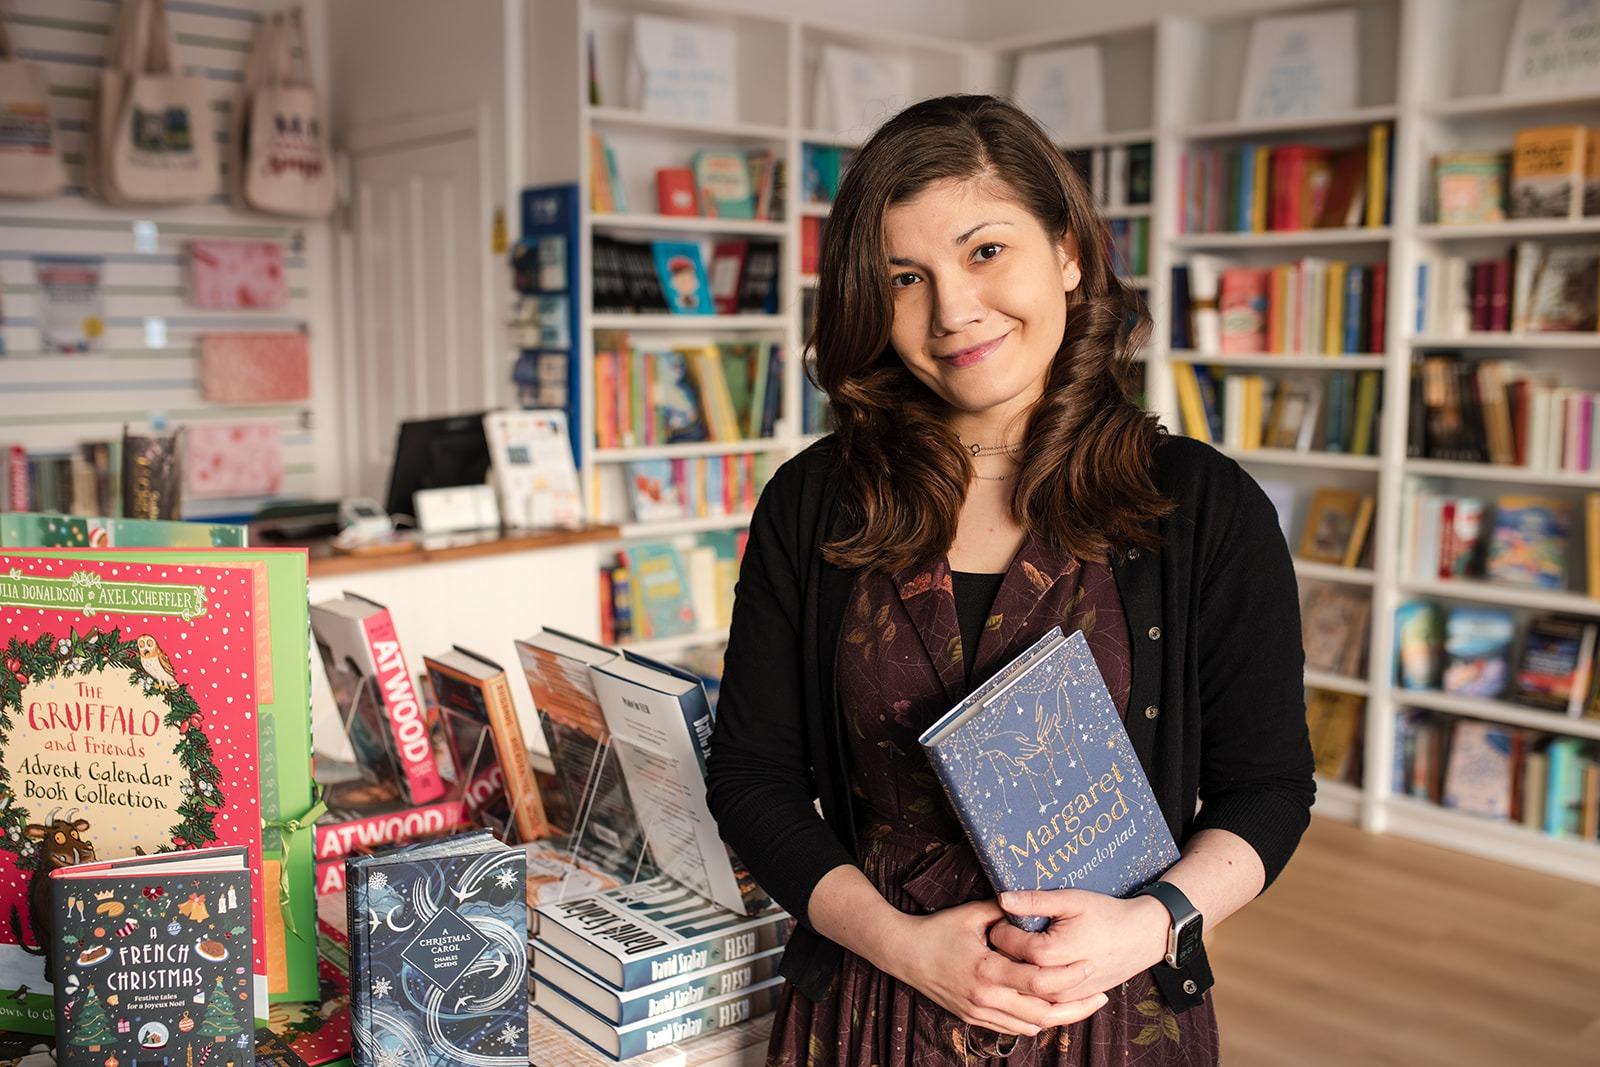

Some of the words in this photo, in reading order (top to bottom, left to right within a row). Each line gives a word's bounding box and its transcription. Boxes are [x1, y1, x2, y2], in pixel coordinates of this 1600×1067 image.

[0, 583, 19, 599] LIA
[21, 584, 84, 603] DONALDSON
[98, 588, 129, 605] AXEL
[131, 589, 193, 608] SCHEFFLER
[74, 681, 103, 699] THE
[373, 641, 429, 763] ATWOOD
[28, 702, 160, 737] GRUFFALO
[44, 734, 77, 753] and
[84, 736, 145, 758] Friends
[16, 754, 81, 780] Advent
[88, 762, 173, 787] Calendar
[23, 780, 68, 801] Book
[75, 785, 168, 810] Collection
[1008, 762, 1125, 868] Margaret
[321, 809, 444, 858] ATWOOD
[1034, 788, 1130, 890] Atwood
[1068, 819, 1137, 887] Penelopiad
[150, 926, 158, 940] A
[419, 933, 471, 947] CHRISTMAS
[442, 928, 449, 936] A
[591, 923, 668, 955] David
[119, 944, 190, 966] FRENCH
[431, 944, 460, 954] CAROL
[433, 955, 459, 963] CHARLES
[651, 955, 677, 981] David
[678, 949, 707, 973] Szalay
[724, 933, 755, 961] FLESH
[434, 961, 458, 969] DICKENS
[107, 967, 203, 991] CHRISTMAS
[134, 994, 159, 1002] Festive
[160, 993, 178, 1001] tales
[648, 992, 674, 1018] David
[721, 967, 751, 994] FLESH
[27, 1008, 39, 1019] to
[646, 1024, 672, 1051] David
[719, 999, 750, 1028] FLESH
